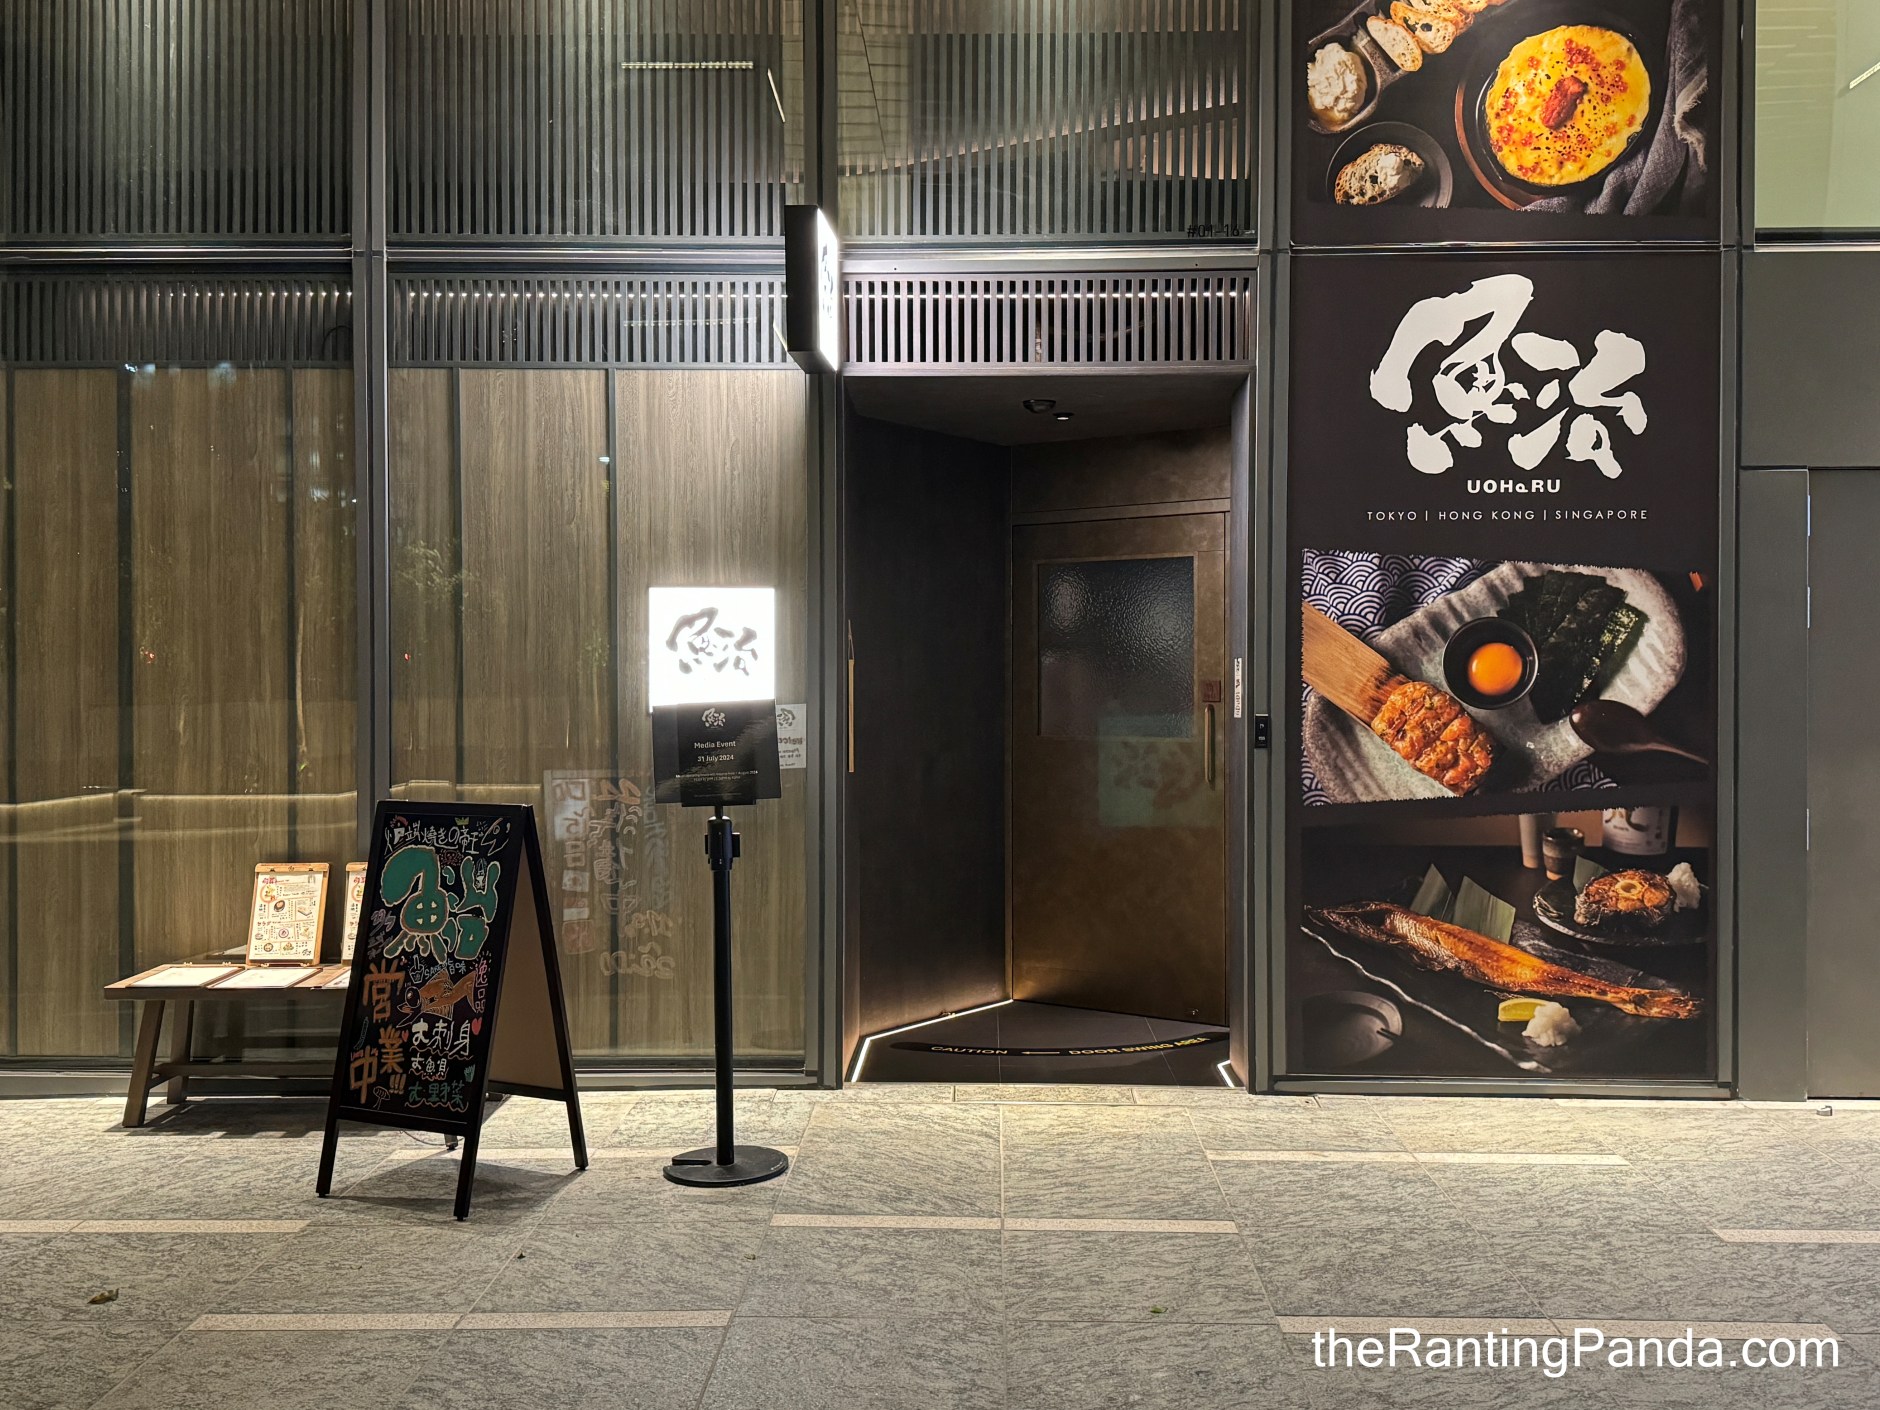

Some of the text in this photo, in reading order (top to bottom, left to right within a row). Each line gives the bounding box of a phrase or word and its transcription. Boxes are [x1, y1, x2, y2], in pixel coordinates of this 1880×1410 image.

[1187, 223, 1240, 238] #01-16
[1366, 509, 1648, 521] TOKYO HONG KONG SINGAPORE
[693, 740, 737, 749] Media Event
[706, 755, 718, 763] July
[931, 1046, 1008, 1054] CAUTION
[1121, 1043, 1174, 1052] SWING
